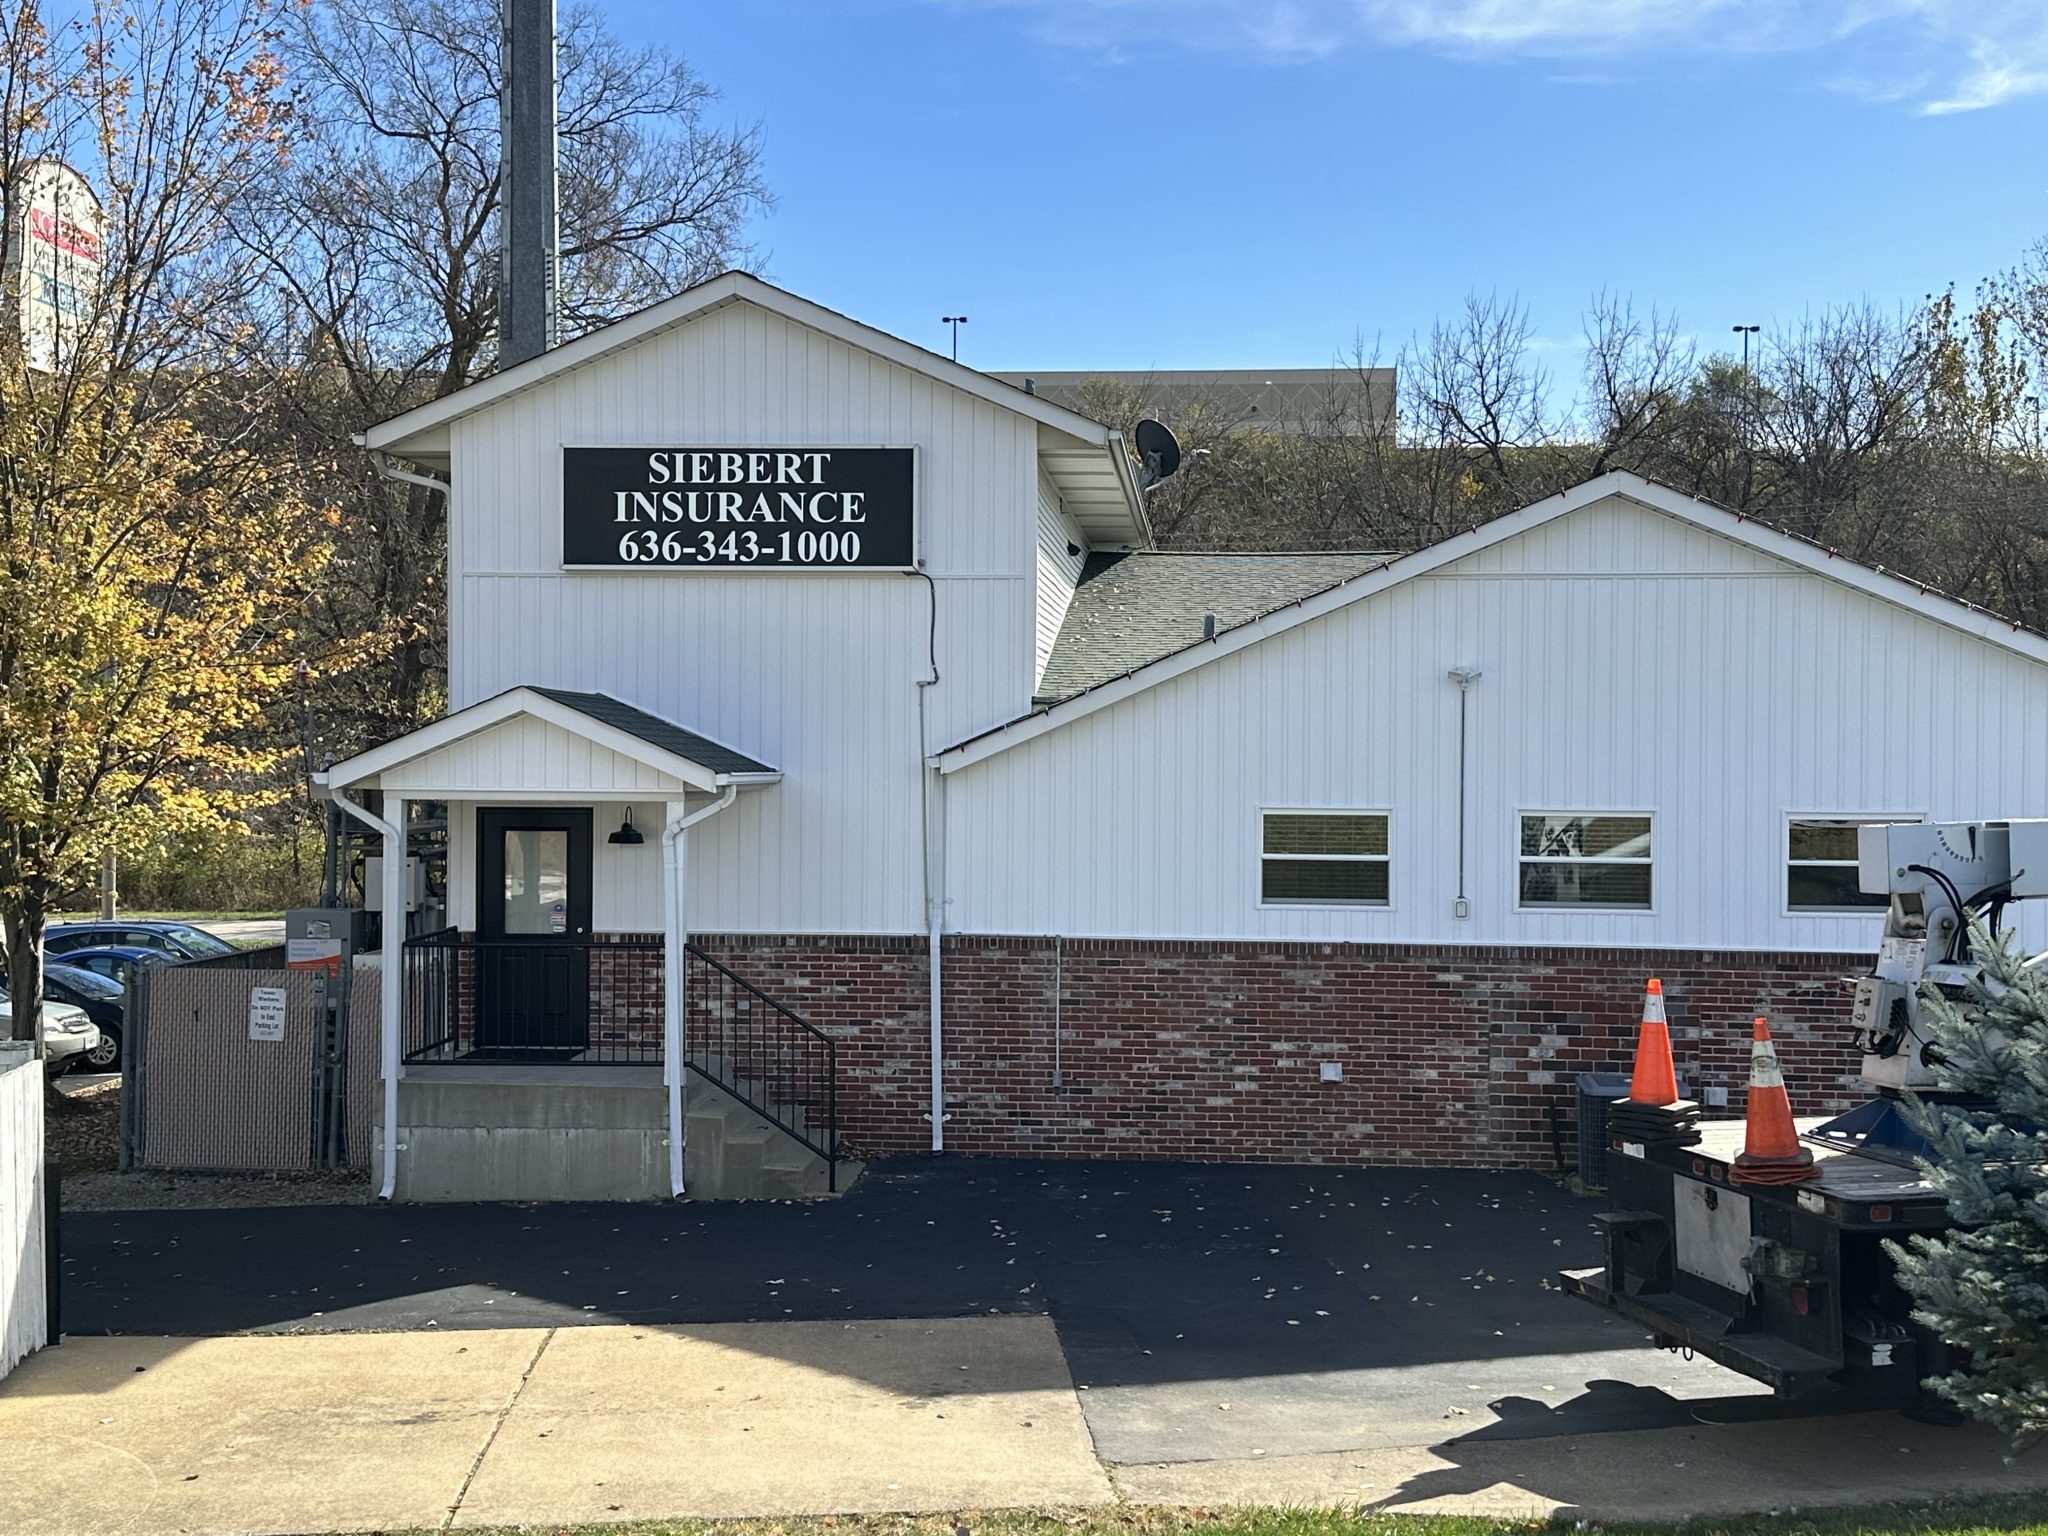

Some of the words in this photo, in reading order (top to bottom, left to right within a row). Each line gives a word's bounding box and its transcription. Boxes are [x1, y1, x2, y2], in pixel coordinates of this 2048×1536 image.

[649, 452, 831, 485] SIEBERT
[613, 491, 866, 523] INSURANCE
[618, 530, 861, 562] 636-343-1000
